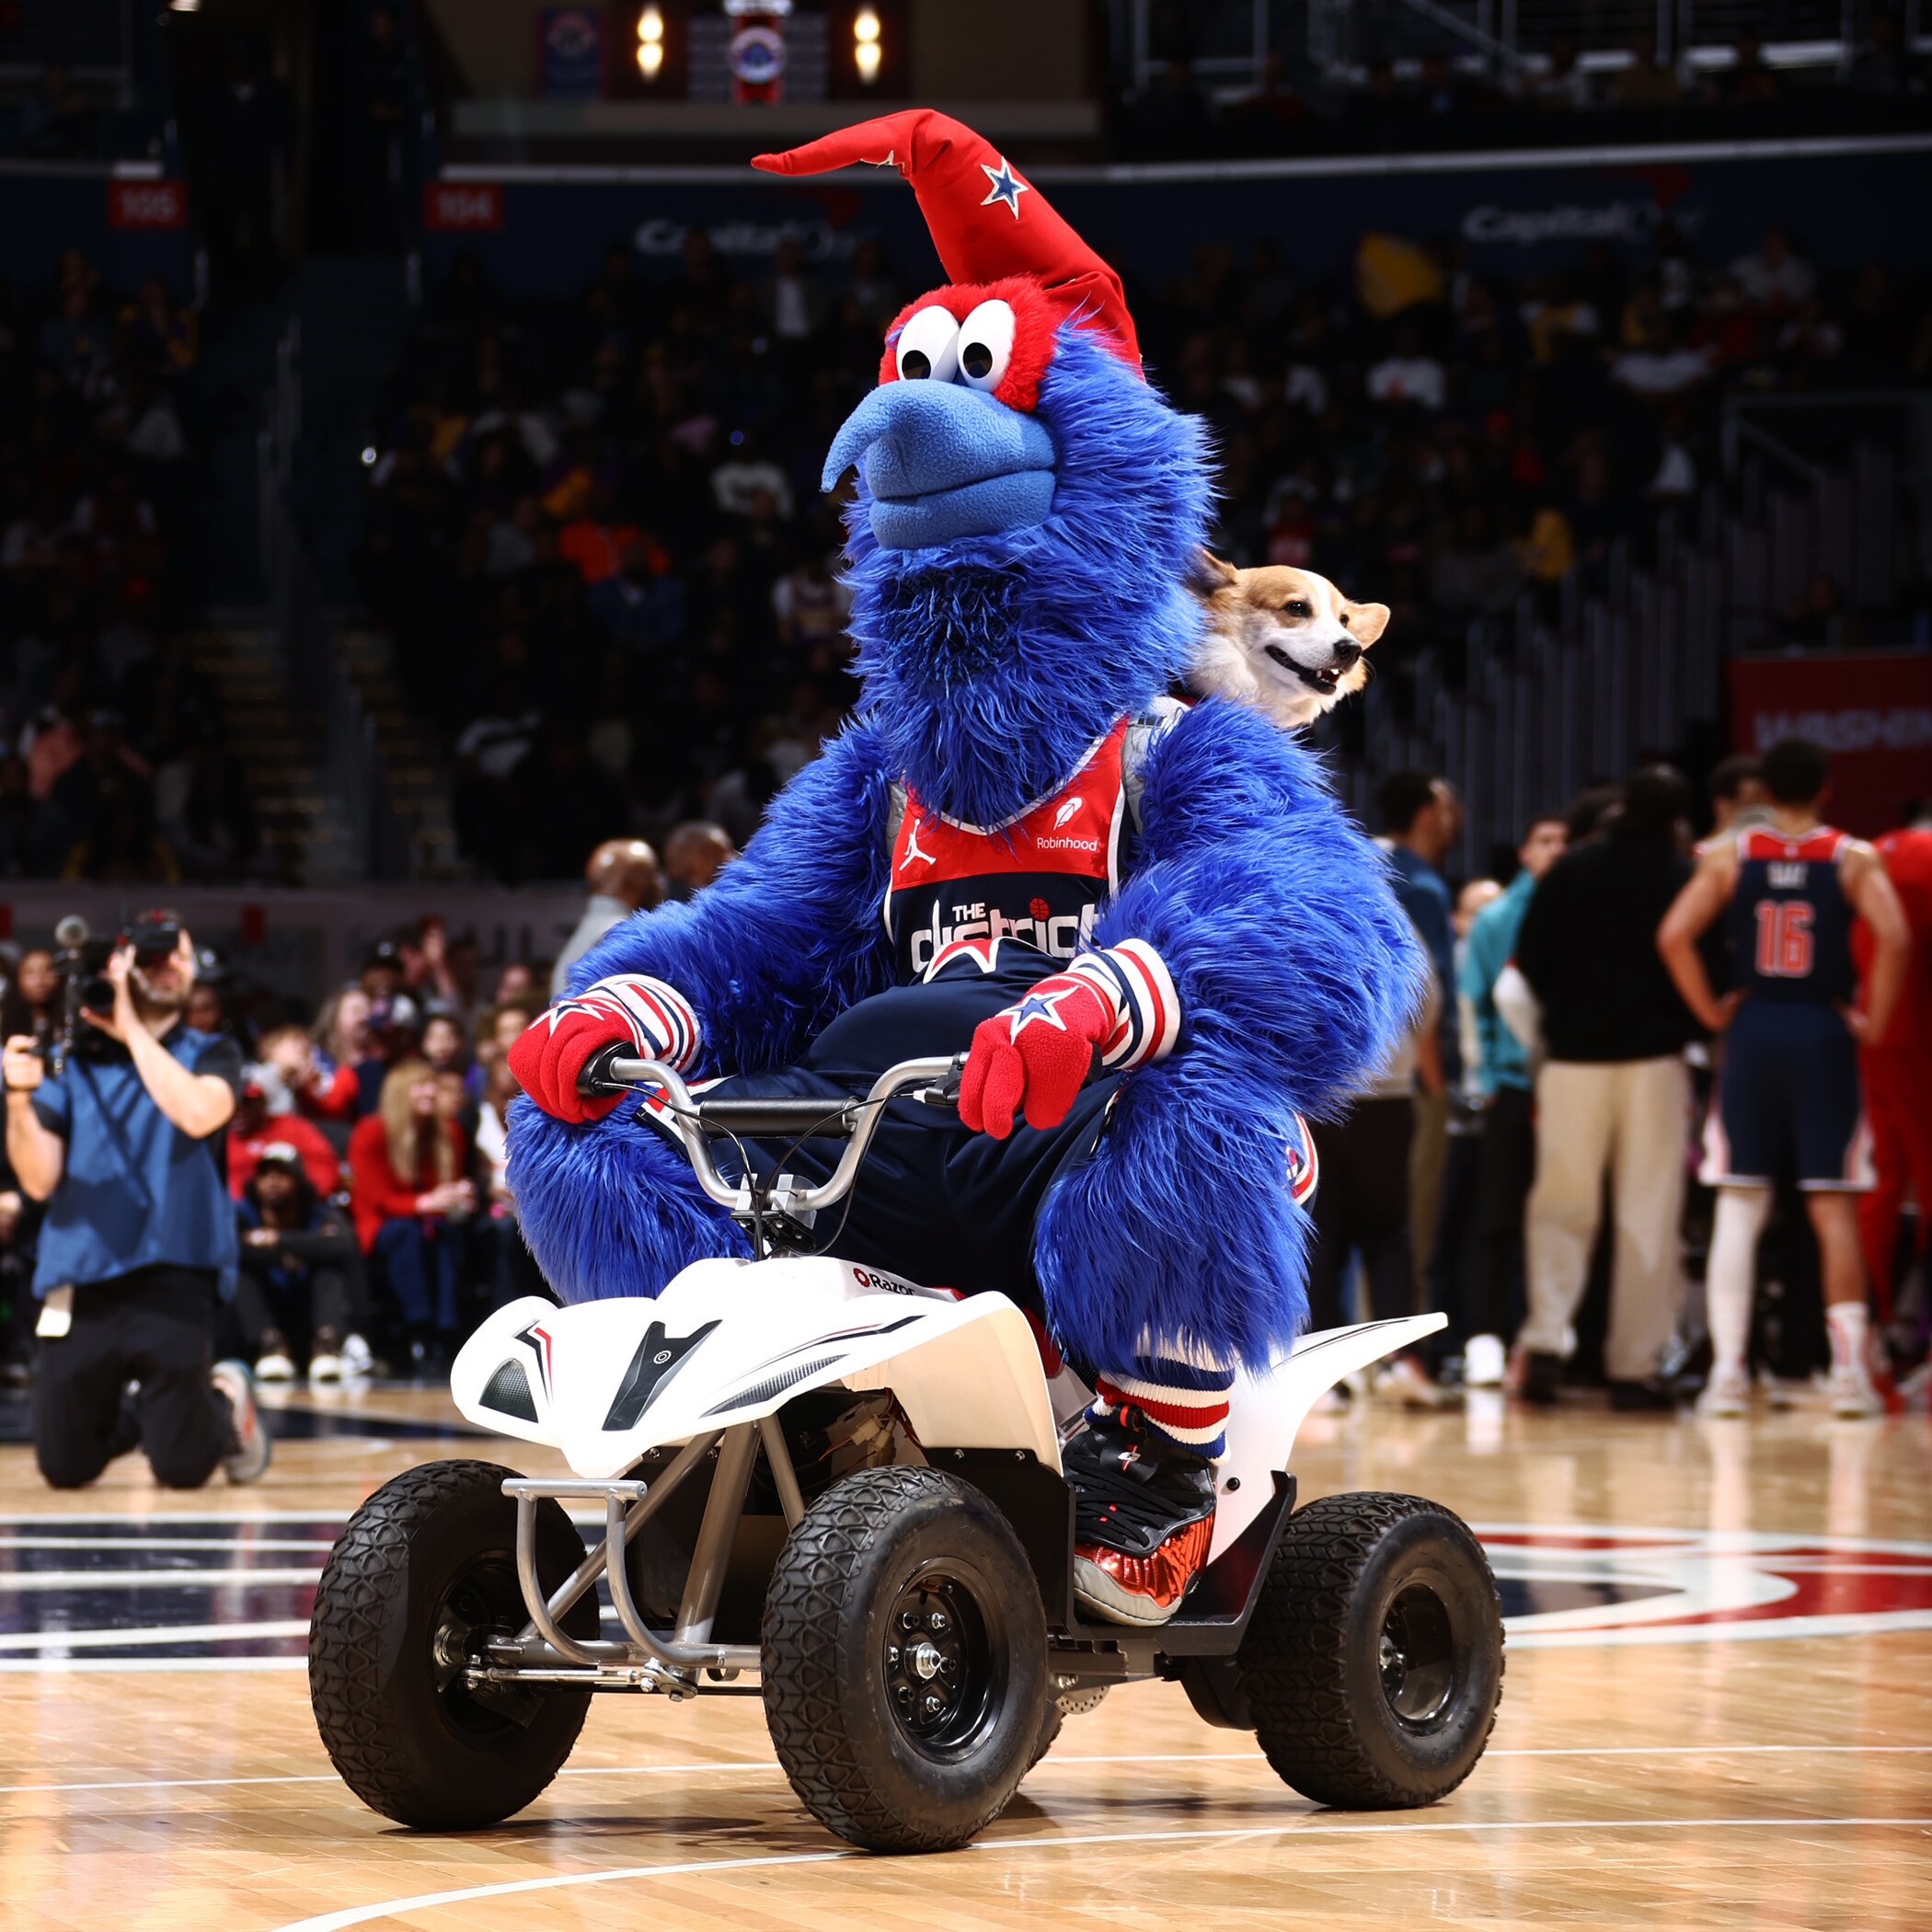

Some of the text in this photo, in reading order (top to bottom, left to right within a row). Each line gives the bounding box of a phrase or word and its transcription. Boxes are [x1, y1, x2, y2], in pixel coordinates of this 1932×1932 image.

[1037, 837, 1098, 852] Robinhood
[951, 902, 987, 923] THE
[1755, 898, 1815, 978] 16
[868, 1272, 916, 1296] Razor
